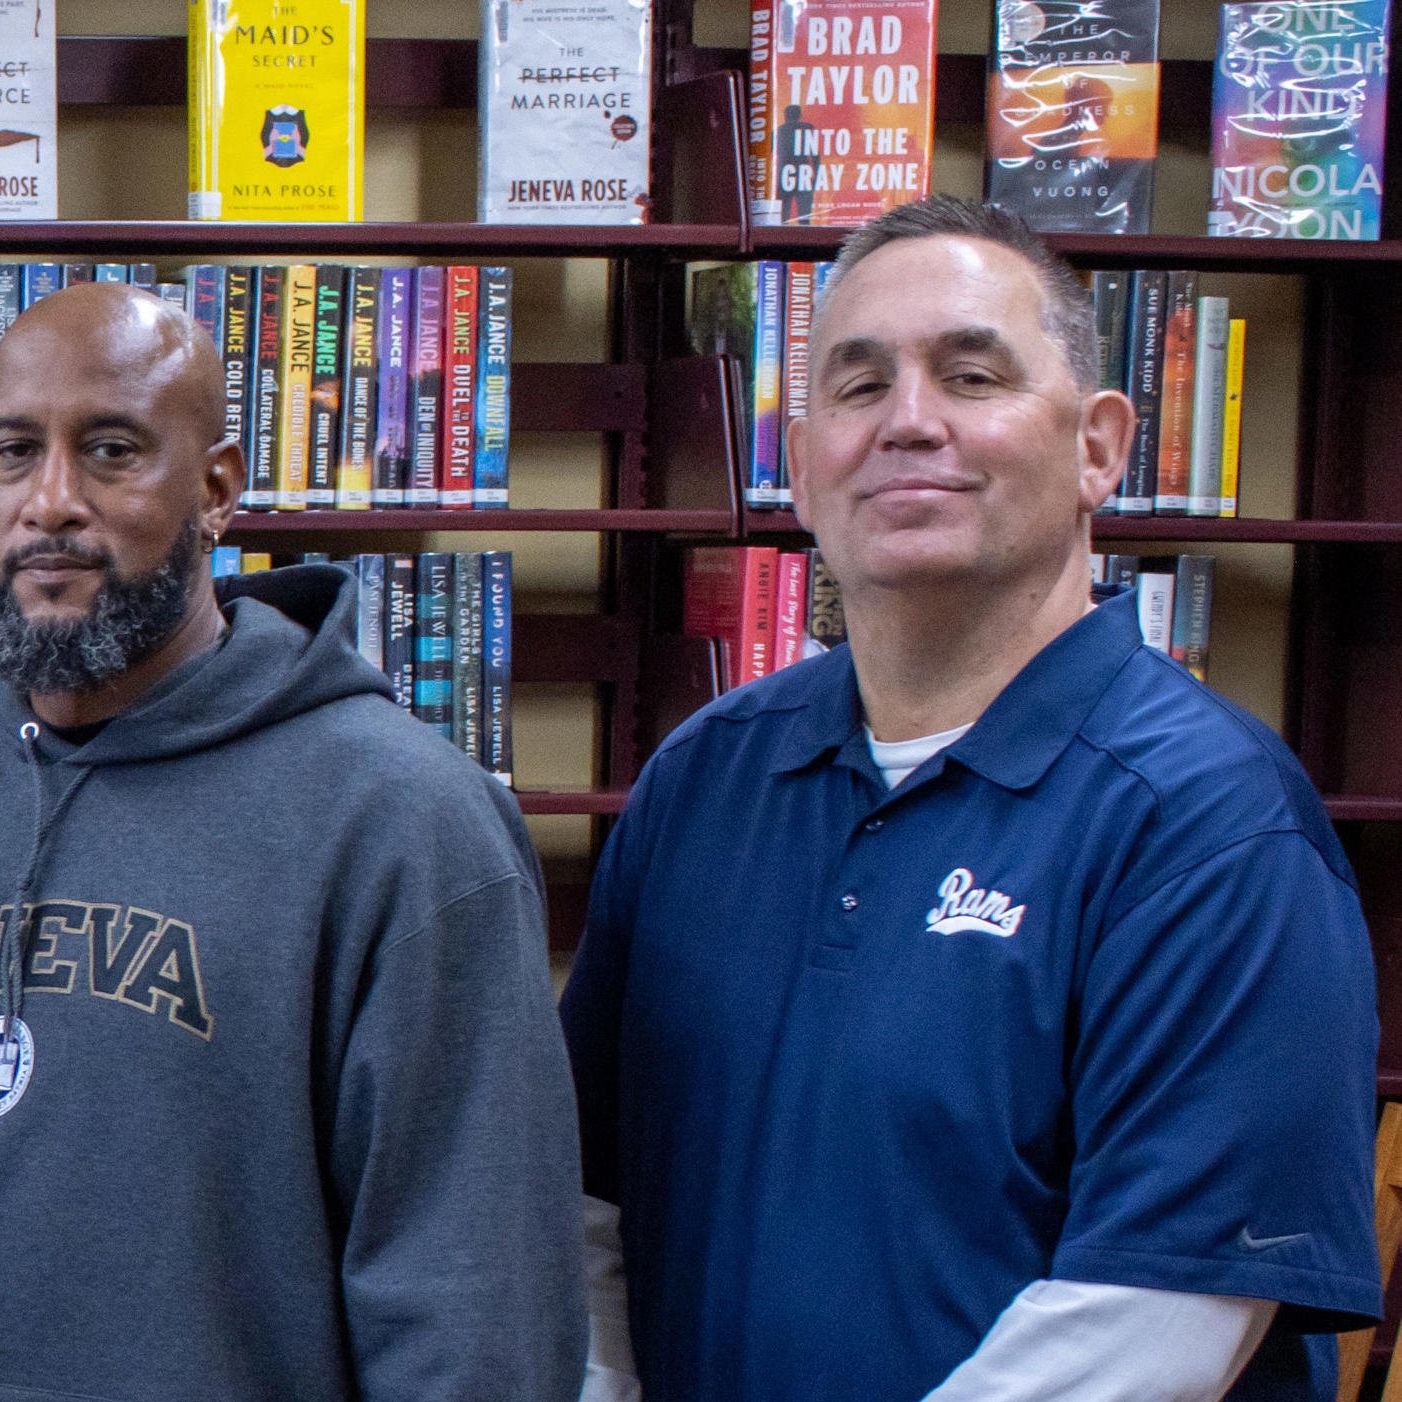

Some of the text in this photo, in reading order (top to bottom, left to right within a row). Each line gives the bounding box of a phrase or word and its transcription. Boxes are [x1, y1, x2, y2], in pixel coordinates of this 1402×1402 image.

[273, 6, 296, 16] THE
[1257, 3, 1355, 32] ONE
[235, 25, 334, 46] MAID'S
[807, 15, 903, 56] BRAD
[1060, 24, 1100, 35] THE
[252, 55, 317, 68] SECRET
[559, 47, 584, 57] THE
[1024, 51, 1130, 62] EMPEROR
[1220, 42, 1388, 77] OF OUR
[522, 67, 621, 84] PERFECT
[749, 9, 770, 143] BRAD TAYLOR
[787, 65, 920, 106] TAYLOR
[510, 93, 631, 109] MARRIAGE
[1246, 89, 1361, 121] KIND
[793, 127, 909, 157] INTO THE
[781, 163, 919, 192] GRAY ZONE
[1035, 160, 1110, 170] OCEAN
[1213, 164, 1382, 198] NICOLA
[233, 184, 336, 198] NITA PROSE
[508, 179, 627, 203] JENEVA ROSE
[1033, 186, 1109, 197] VUONG
[764, 268, 776, 325] JONATHAN
[227, 307, 245, 399] JANCE COLD
[291, 319, 311, 373] JANCE
[354, 316, 373, 367] JANCE
[789, 273, 811, 417] JONATHAN KELLERMAN
[452, 309, 470, 477] JANCE DUEL DEATH
[485, 315, 506, 451] JANCE DOWNFALL
[316, 320, 338, 485] JANCE CRUEL INTENT
[258, 369, 274, 478] COLLATERAL DAMAGE
[391, 582, 404, 641] JEWELL
[492, 573, 503, 628] FOUND
[926, 868, 1026, 937] Rams
